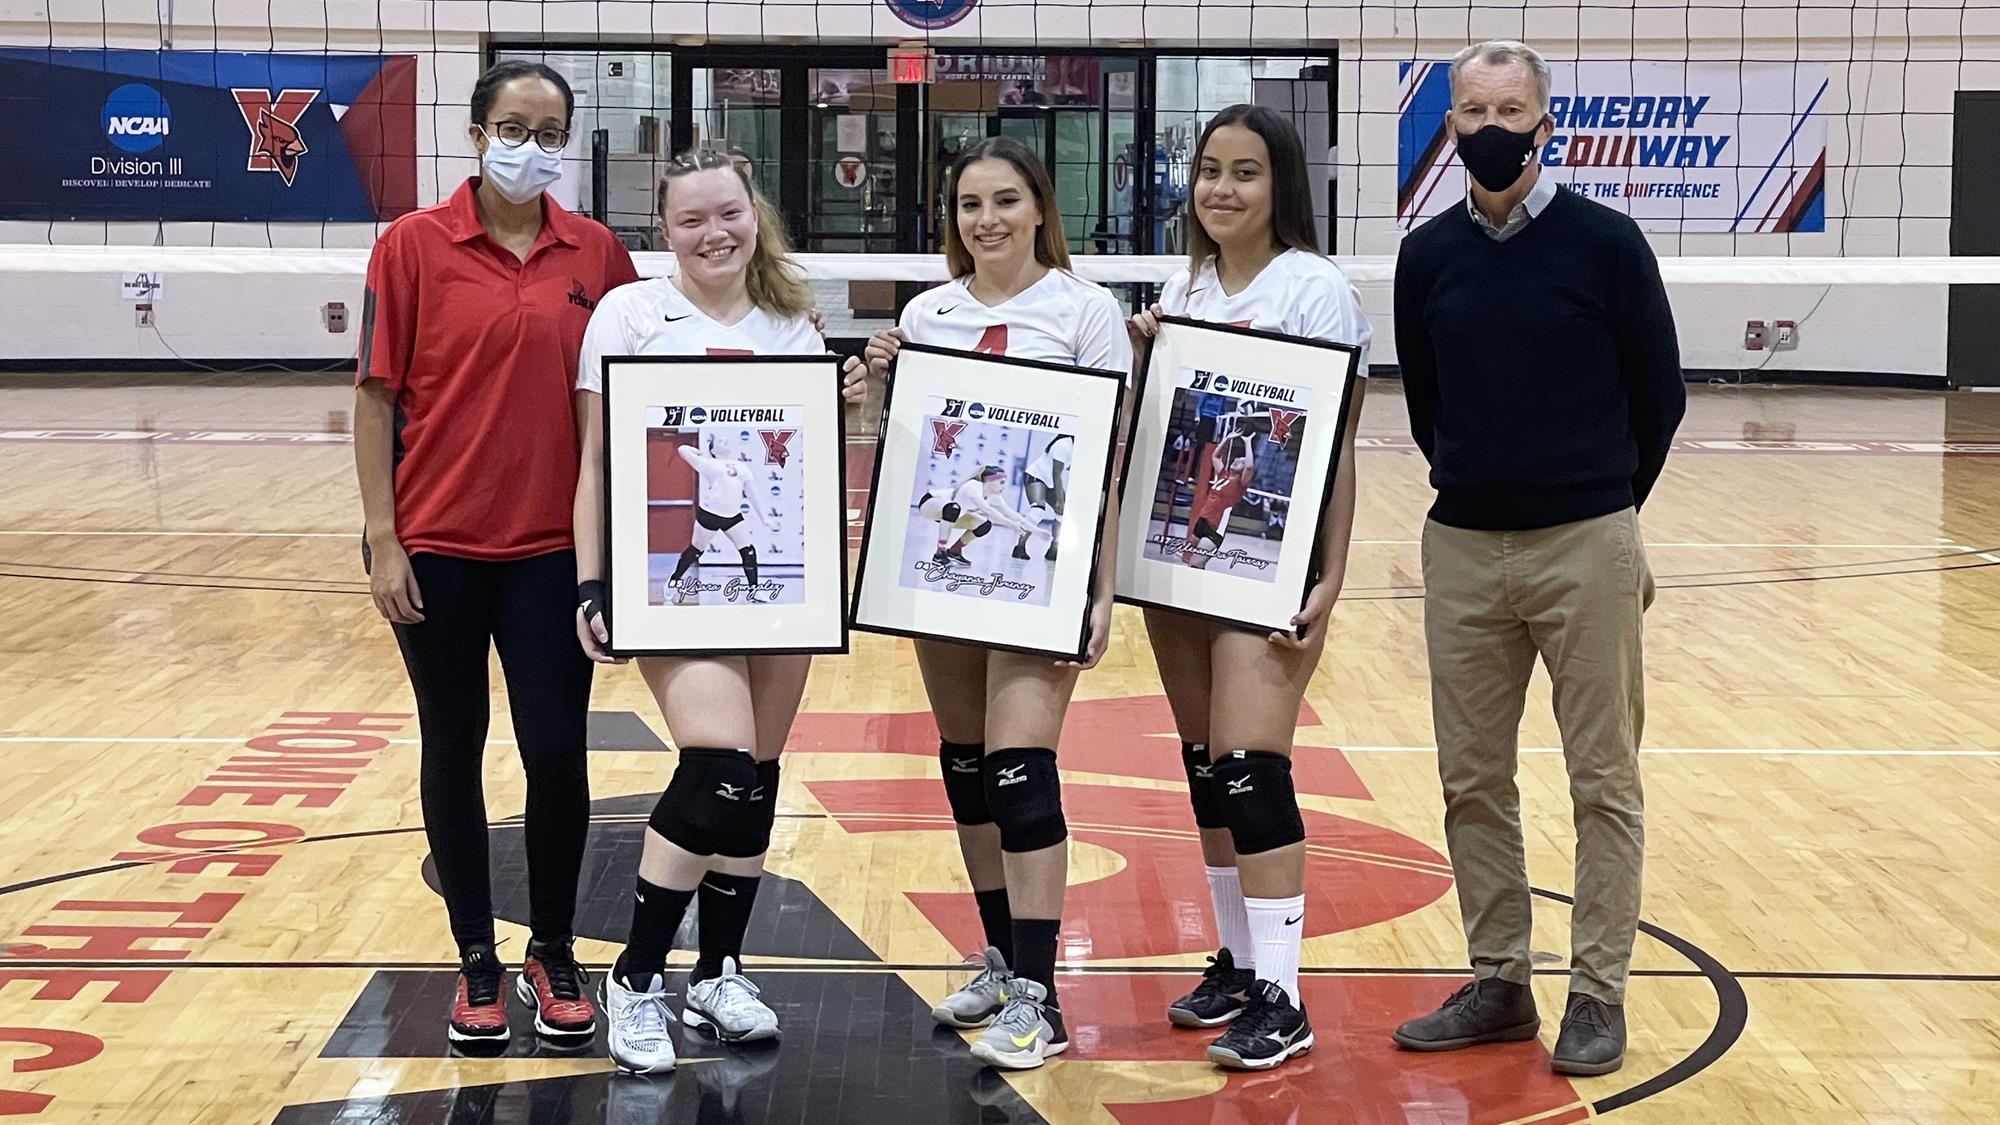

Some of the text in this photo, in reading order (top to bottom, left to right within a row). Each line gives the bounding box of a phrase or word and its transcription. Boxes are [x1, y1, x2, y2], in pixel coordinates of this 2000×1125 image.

[936, 55, 1046, 72] ORIUM
[1550, 96, 1711, 129] AMEDAY
[108, 116, 169, 135] NCAA
[1540, 135, 1731, 167] EDIIIWAY
[91, 157, 182, 175] Division III
[115, 179, 159, 188] DEVELOP
[164, 180, 211, 188] DEDICATE
[1594, 183, 1621, 198] THE
[1230, 379, 1296, 403] VOLLEYBALL
[710, 409, 785, 422] VOLLEYBALL
[988, 406, 1060, 429] VOLLEYBALL
[176, 711, 416, 808] HOME
[110, 821, 306, 877] OF
[0, 892, 247, 1003] THE
